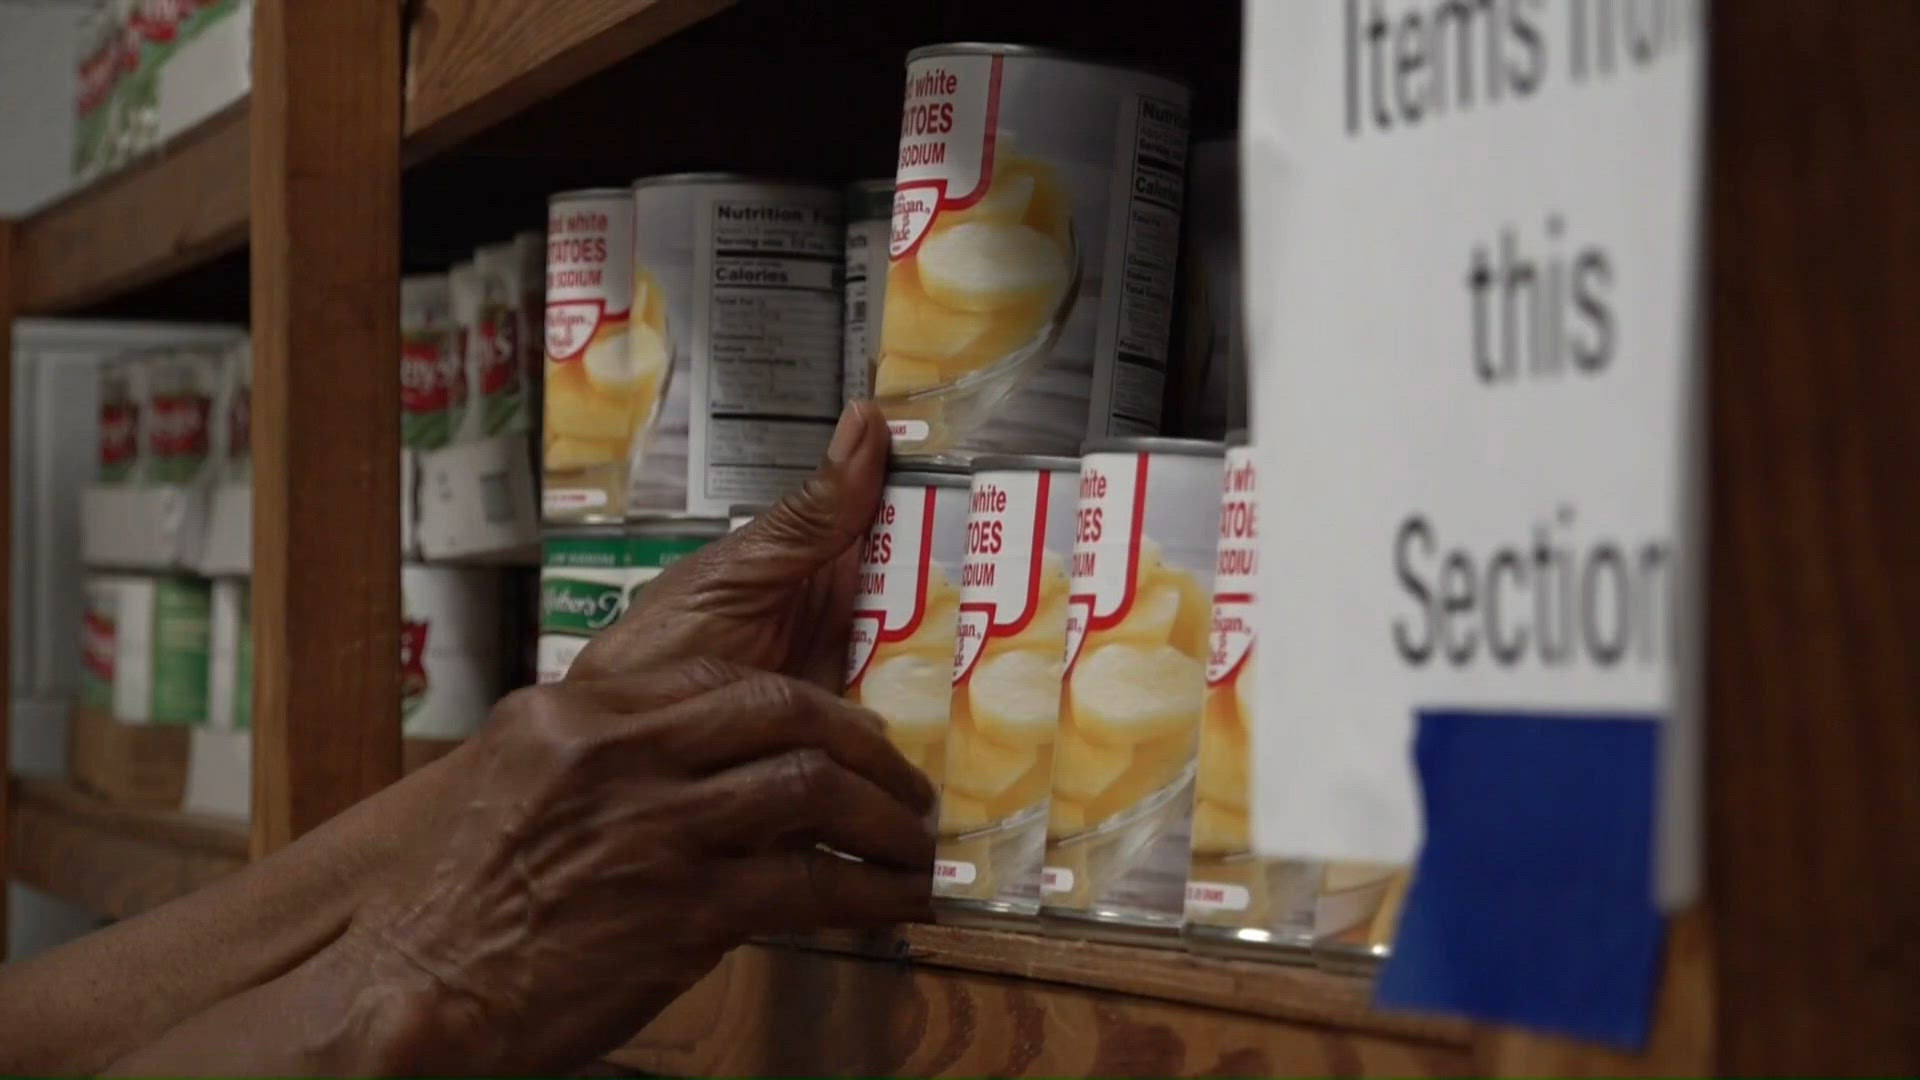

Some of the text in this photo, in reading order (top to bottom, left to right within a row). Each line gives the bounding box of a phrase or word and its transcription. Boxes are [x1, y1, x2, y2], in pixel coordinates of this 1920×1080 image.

[916, 68, 957, 97] white
[716, 265, 790, 283] Calories
[1466, 213, 1615, 385] this
